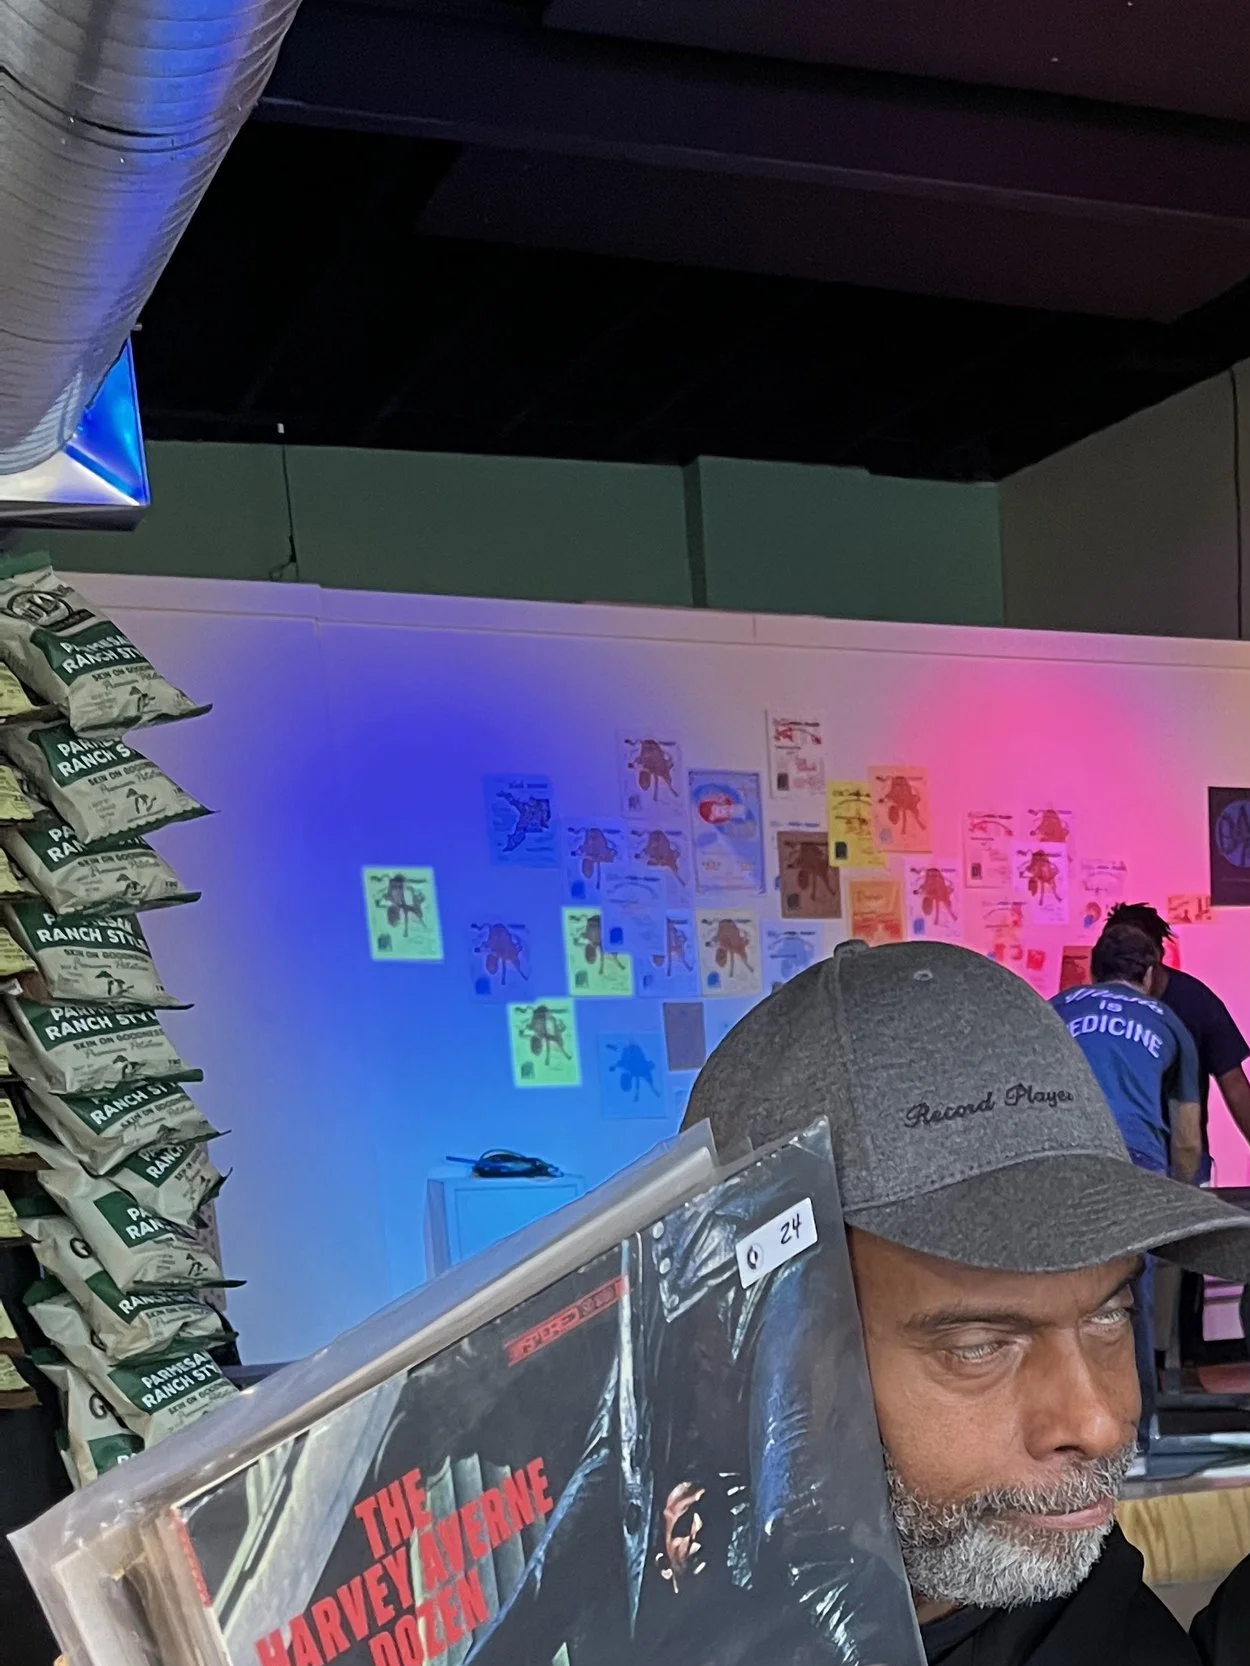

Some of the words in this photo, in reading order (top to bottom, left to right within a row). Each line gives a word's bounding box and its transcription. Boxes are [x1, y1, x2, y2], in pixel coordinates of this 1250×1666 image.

[57, 749, 118, 777] RANCH
[47, 837, 88, 863] RAN
[36, 927, 103, 943] RANCH
[45, 1016, 113, 1041] RANCH
[117, 1010, 157, 1027] STYL
[1067, 1014, 1164, 1059] EDICINE
[90, 1089, 149, 1126] RANCH
[904, 1091, 996, 1128] Record
[1004, 1083, 1074, 1108] Player
[780, 1212, 803, 1245] 24
[141, 1350, 208, 1389] PARMESA
[141, 1373, 196, 1409] RANCH
[354, 1467, 433, 1560] THE
[417, 1456, 554, 1590] AVERNE
